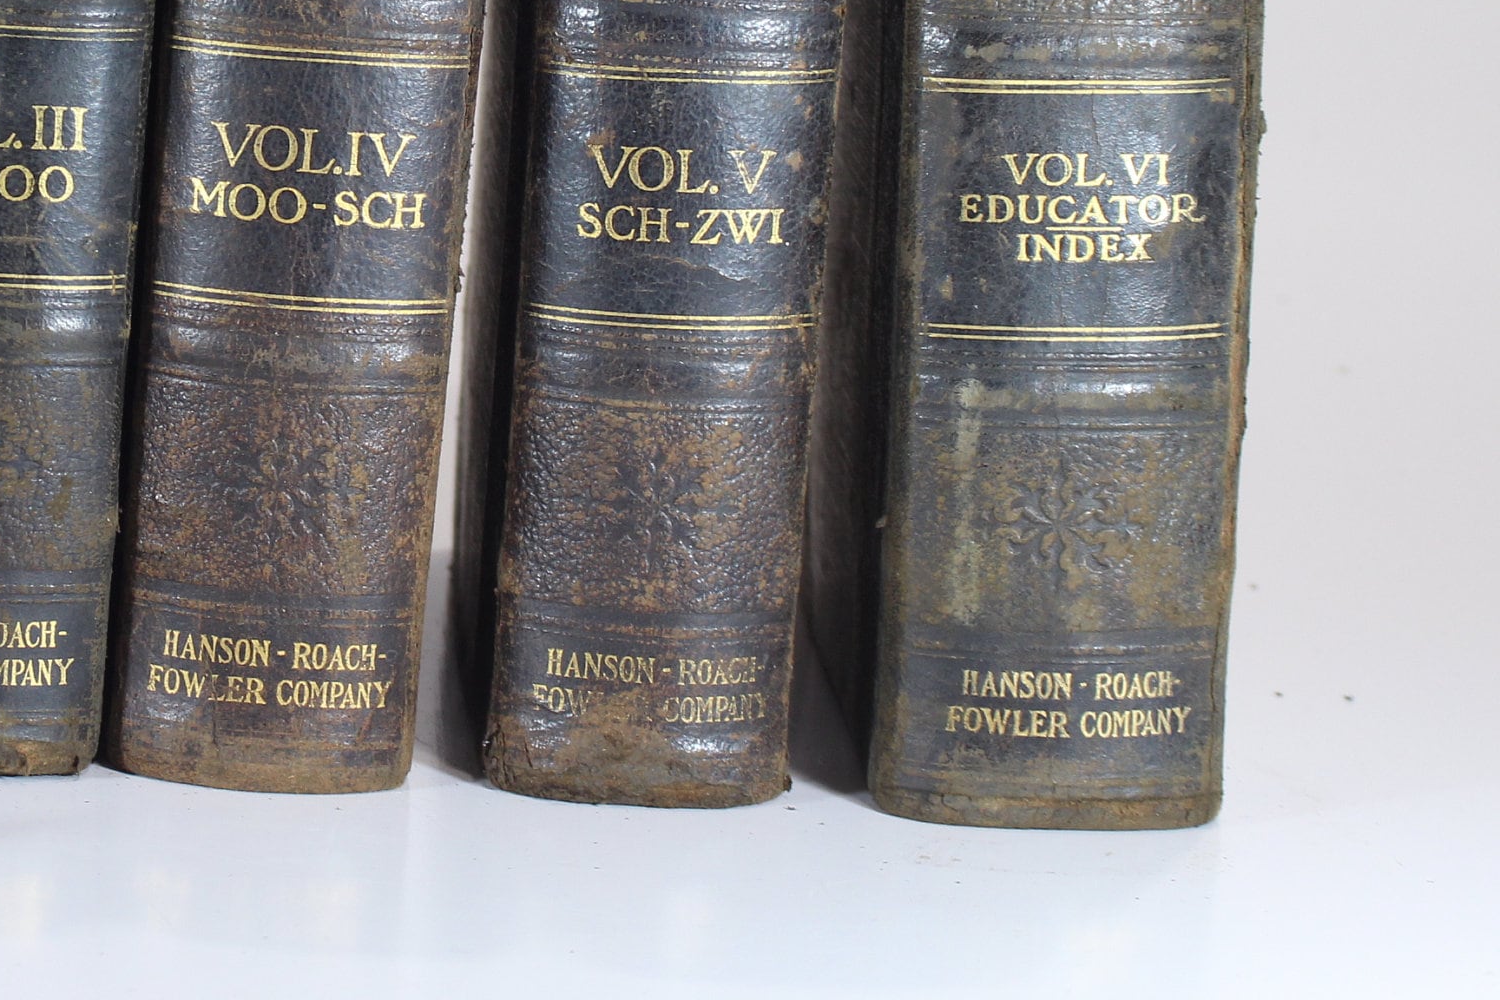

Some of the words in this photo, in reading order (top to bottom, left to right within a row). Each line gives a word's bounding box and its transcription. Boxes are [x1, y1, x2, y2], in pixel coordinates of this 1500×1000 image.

[588, 144, 720, 194] VOL.
[728, 150, 777, 195] V
[958, 193, 1206, 225] EDUCATOR
[1016, 233, 1154, 263] INDEX
[148, 664, 267, 705] FOWLER
[276, 680, 392, 709] COMPANY
[662, 692, 766, 724] COMPANY
[945, 705, 1071, 739] FOWLER
[1080, 706, 1192, 738] COMPANY
